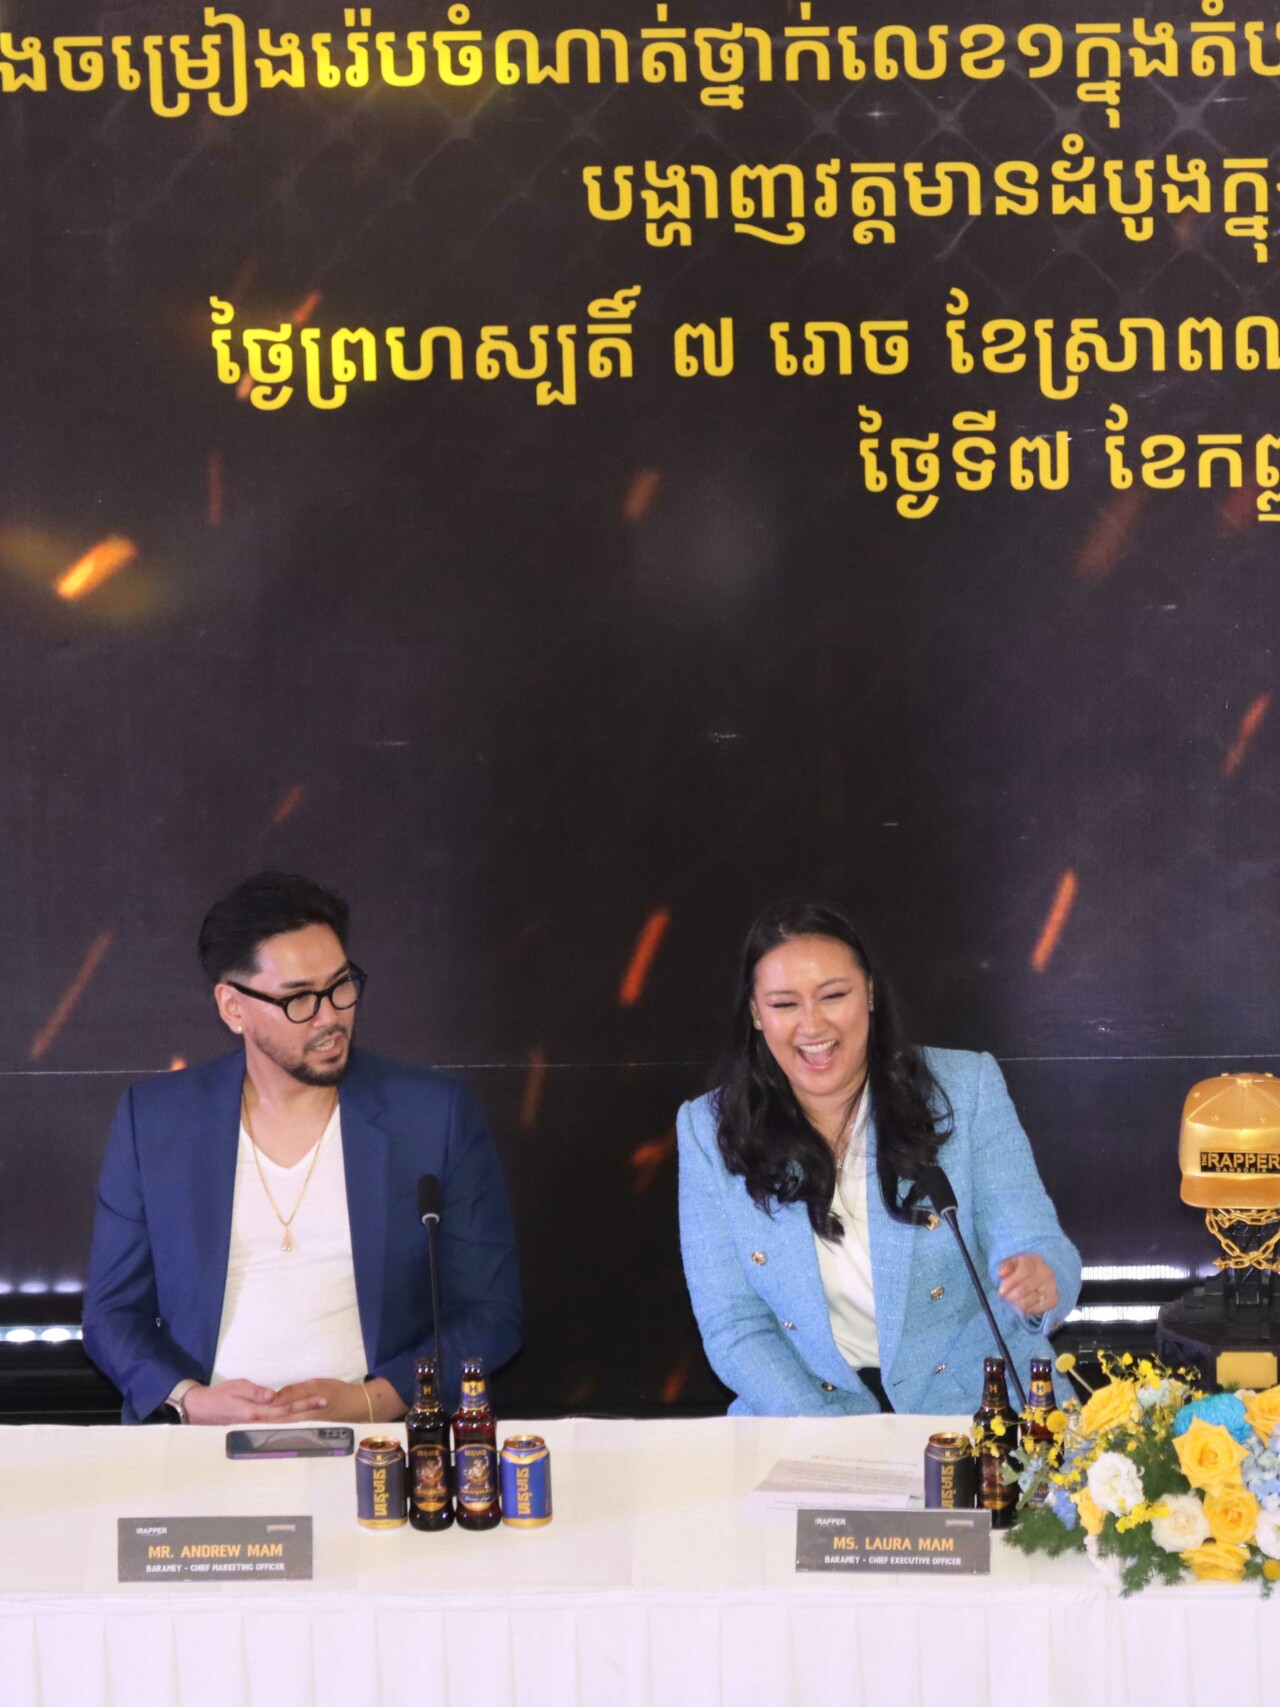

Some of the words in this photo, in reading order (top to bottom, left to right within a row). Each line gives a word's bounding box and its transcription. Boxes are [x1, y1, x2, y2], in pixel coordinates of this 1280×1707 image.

[674, 317, 734, 377] ៧
[769, 321, 909, 376] រោច
[858, 405, 1070, 519] ថ្ងៃទី៧
[817, 1518, 846, 1526] RAPPER
[138, 1527, 167, 1535] RAPPER
[833, 1536, 858, 1550] MS.
[865, 1537, 912, 1550] LAURA
[918, 1537, 954, 1551] MAM
[148, 1545, 174, 1559] MR.
[180, 1544, 241, 1559] ANDREW
[247, 1543, 283, 1557] MAM
[824, 1556, 860, 1564] BARAMEY
[868, 1556, 888, 1564] CHIEF
[890, 1556, 931, 1565] EXECUTIVE
[932, 1557, 961, 1566] OFFICER
[145, 1564, 182, 1573] BARAMEY
[190, 1564, 210, 1572] CHIEF
[212, 1563, 254, 1572] MARKETING
[255, 1563, 285, 1571] OFFICER
